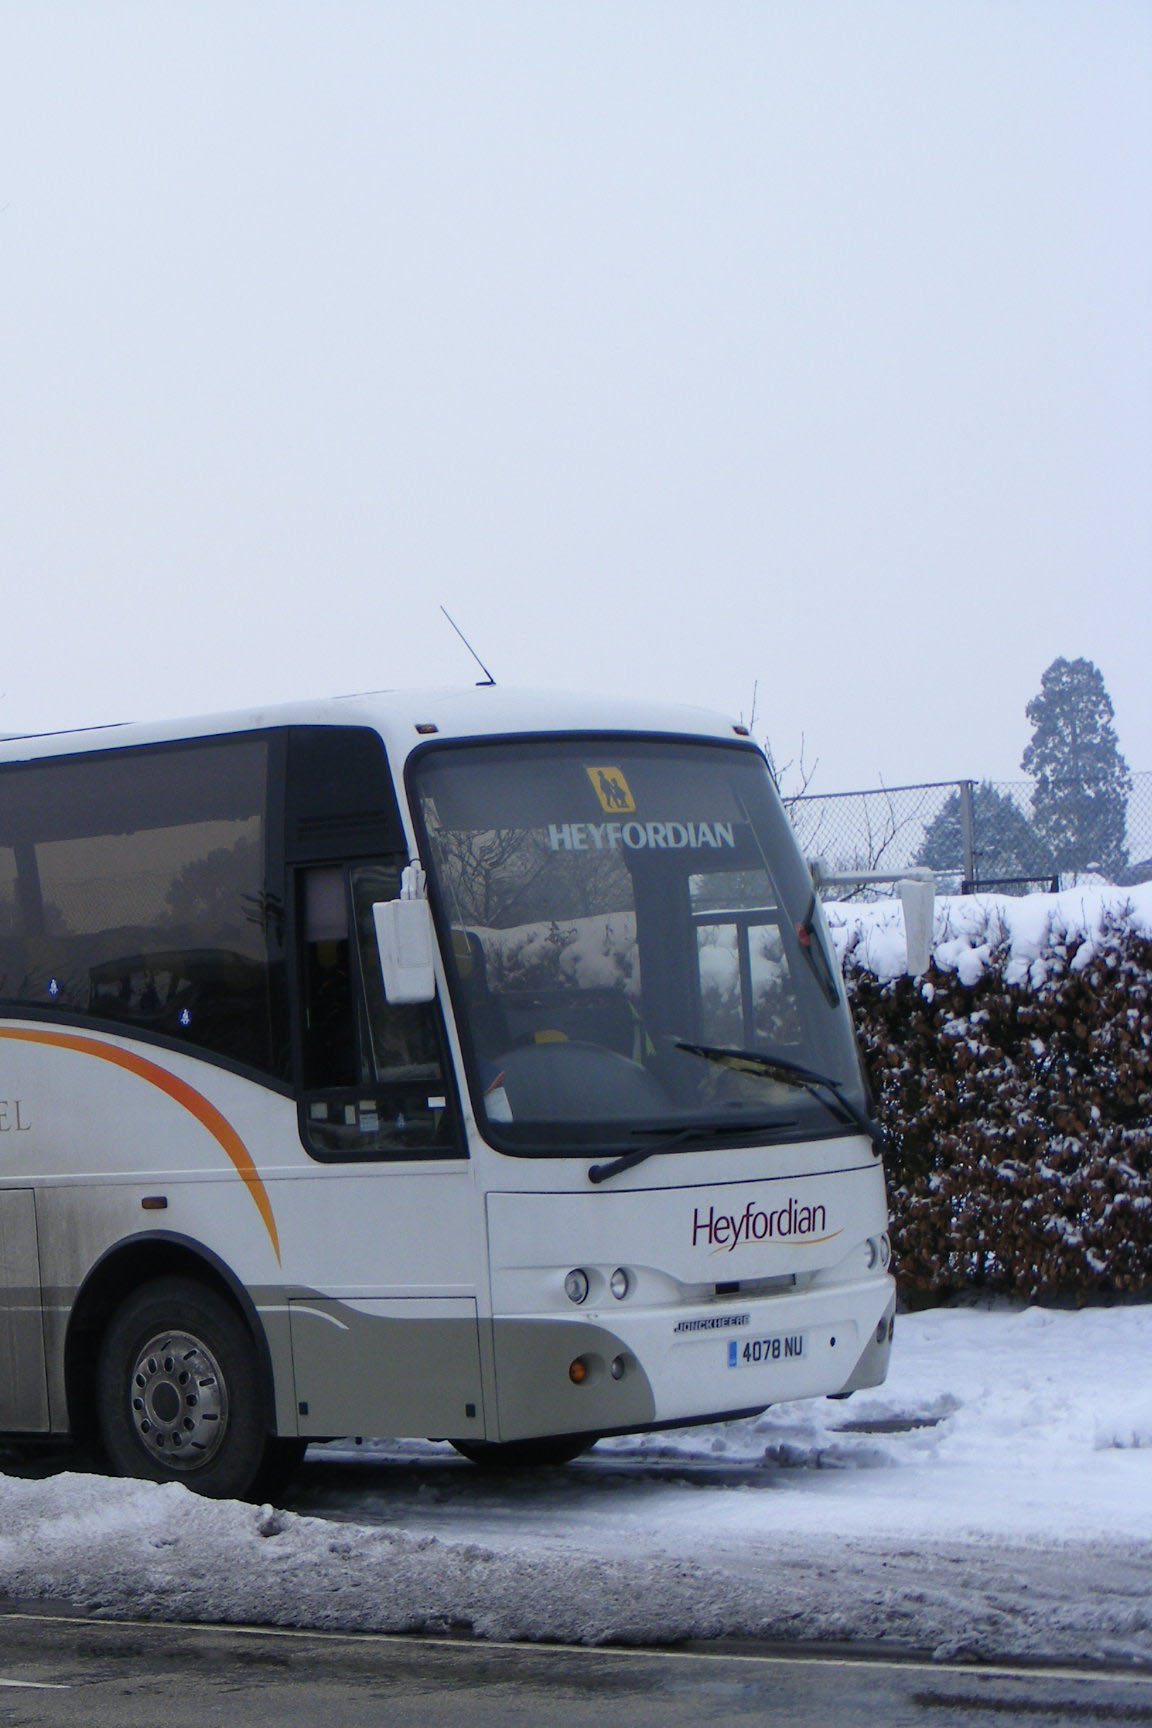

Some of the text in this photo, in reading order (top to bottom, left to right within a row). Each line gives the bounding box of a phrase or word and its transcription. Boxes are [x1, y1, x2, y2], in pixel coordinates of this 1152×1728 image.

[548, 821, 736, 851] HEYFORDIAN
[692, 1197, 826, 1253] Heyfordian
[673, 1313, 751, 1333] JONCKHEERE
[742, 1335, 804, 1363] 4078 NU
